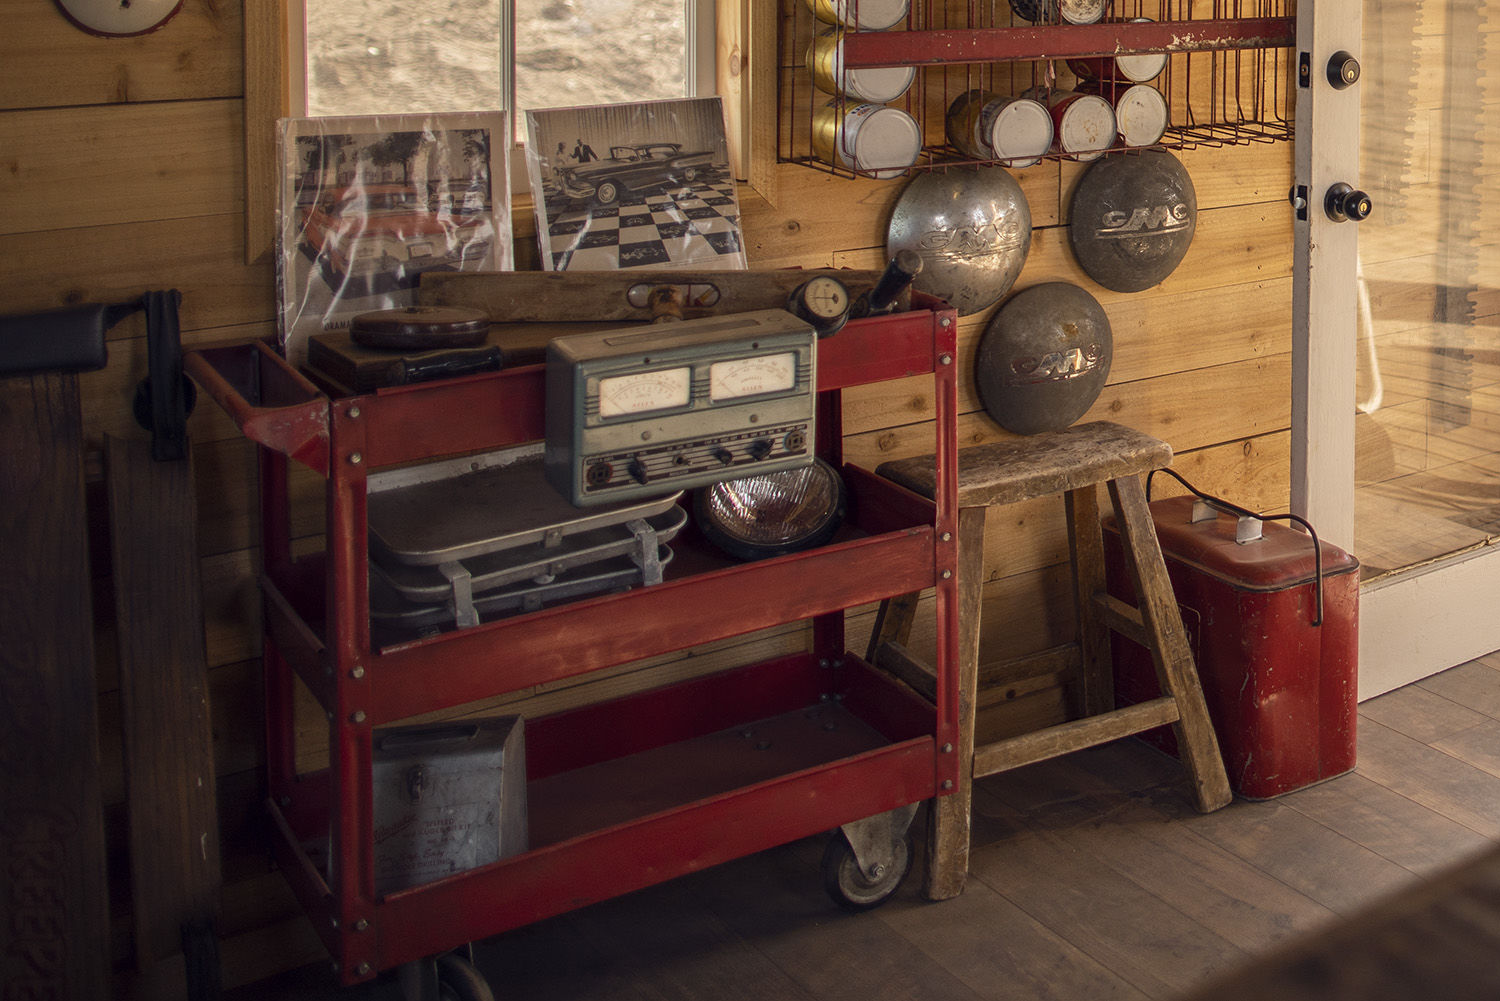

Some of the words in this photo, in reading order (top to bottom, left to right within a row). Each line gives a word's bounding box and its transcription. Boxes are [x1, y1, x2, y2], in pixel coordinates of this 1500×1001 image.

[1102, 202, 1188, 229] GMC
[919, 222, 1018, 249] GMC
[1010, 343, 1097, 377] GMC
